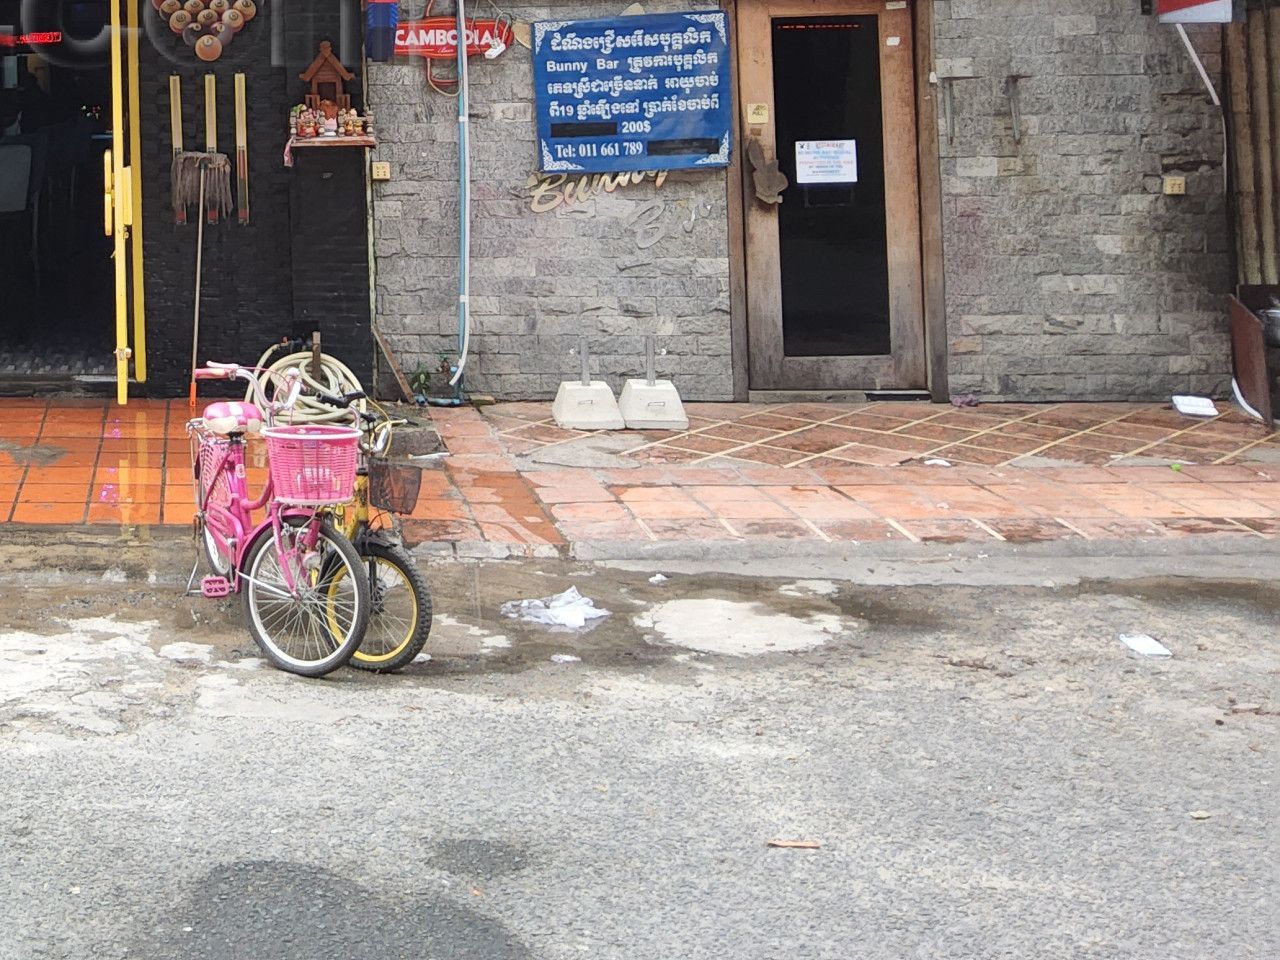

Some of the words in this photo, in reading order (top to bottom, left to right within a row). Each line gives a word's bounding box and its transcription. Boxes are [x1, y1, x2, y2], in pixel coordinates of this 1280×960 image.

[395, 29, 494, 46] CAMBODIA
[546, 60, 588, 73] Bunny
[596, 58, 619, 70] Bar
[622, 120, 651, 133] 200$
[555, 144, 576, 158] Tel:
[579, 143, 597, 157] 011
[600, 143, 619, 156] 661
[623, 142, 643, 155] 789
